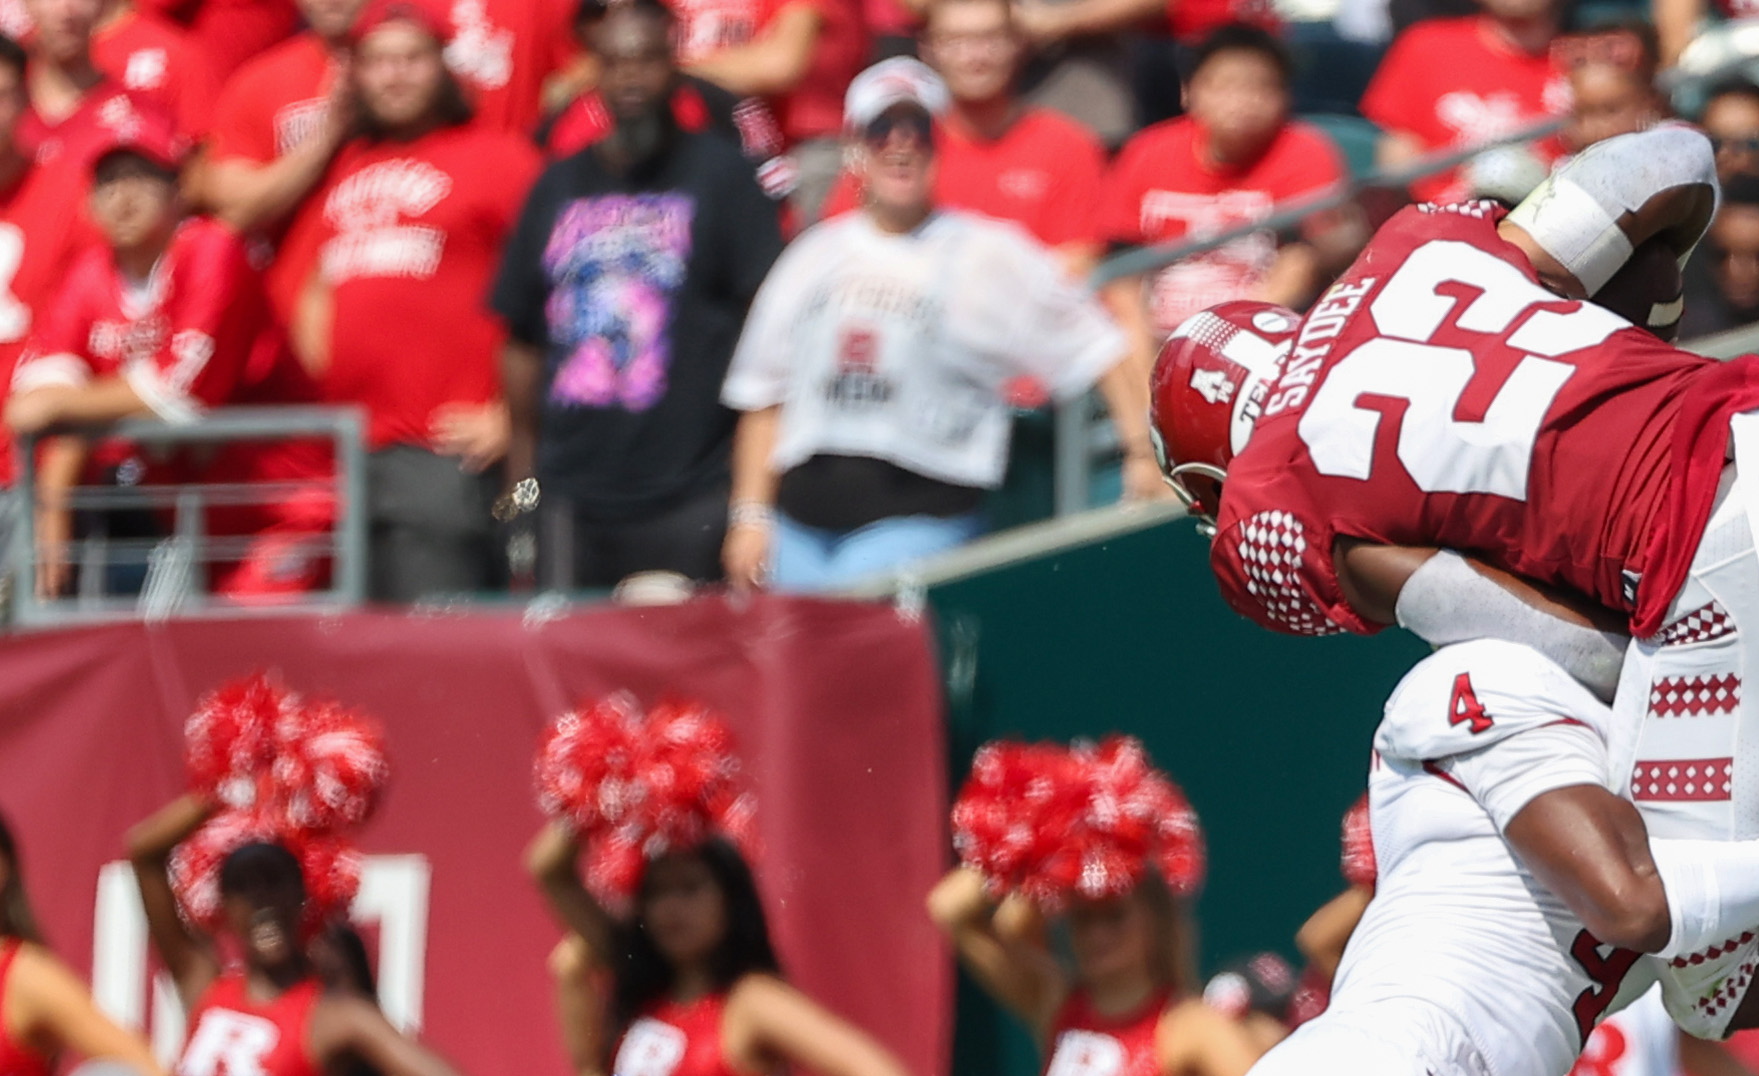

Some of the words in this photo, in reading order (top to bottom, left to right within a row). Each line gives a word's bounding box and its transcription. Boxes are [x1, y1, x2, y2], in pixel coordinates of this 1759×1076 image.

[1263, 276, 1378, 417] SAYDEE
[1297, 238, 1635, 502] 23
[1448, 671, 1496, 735] 4
